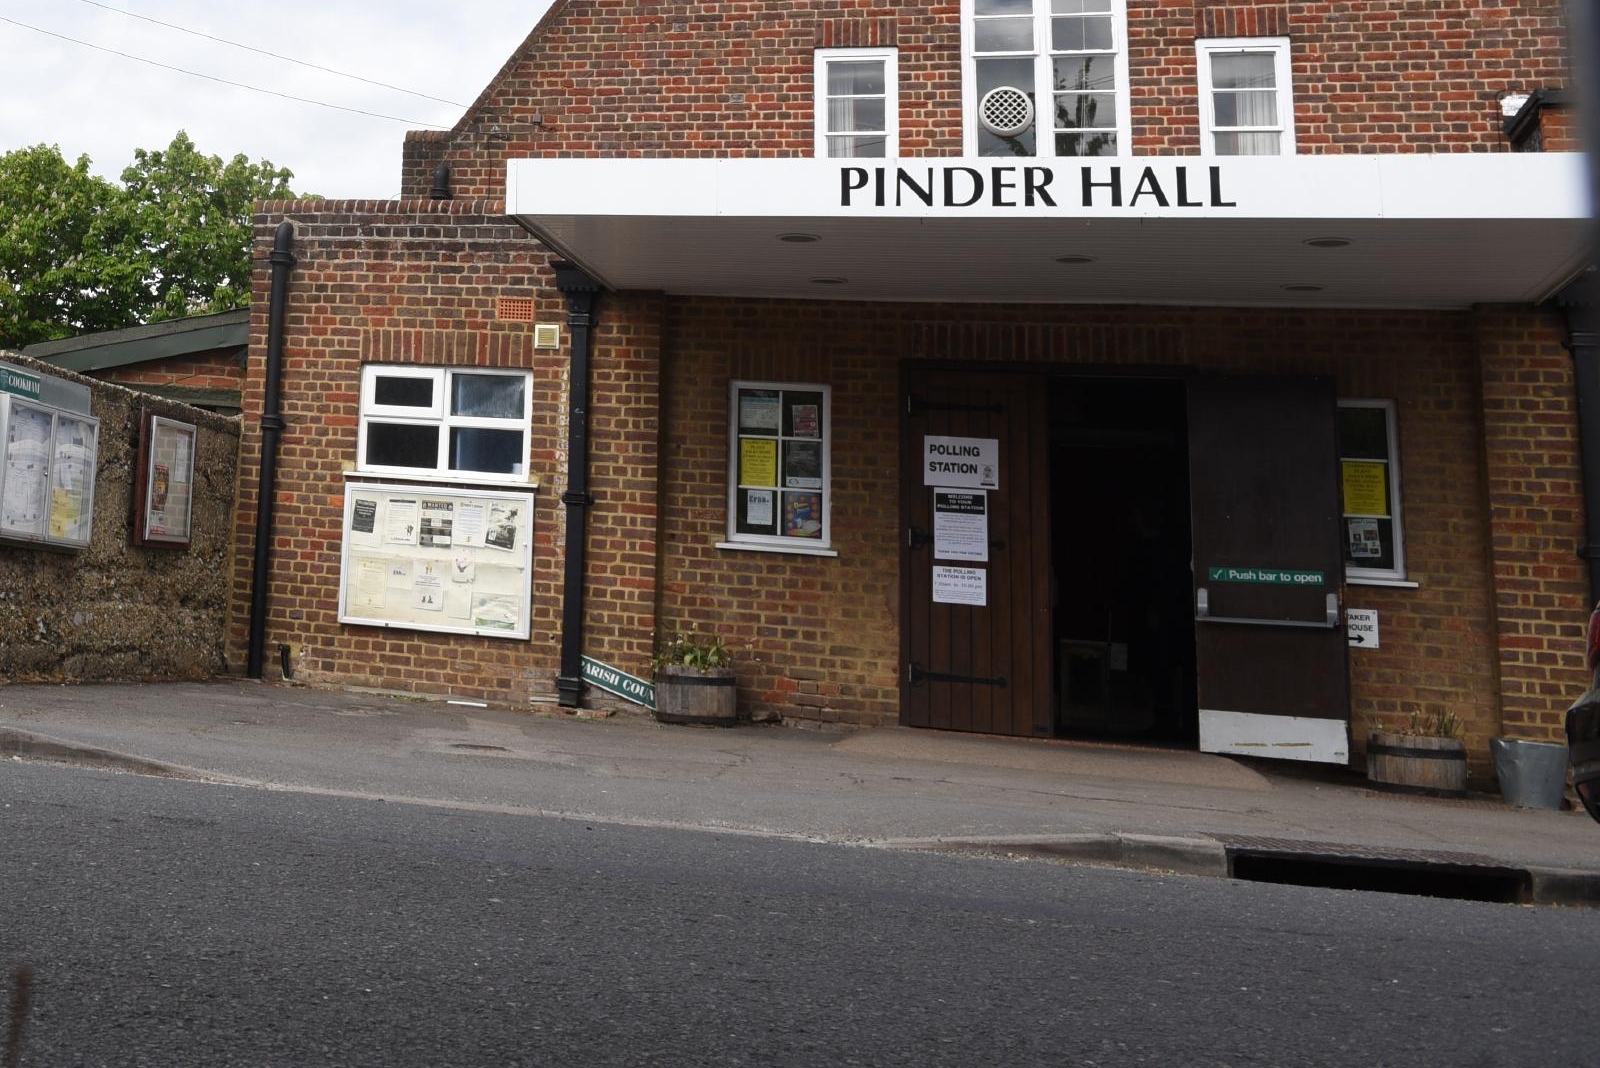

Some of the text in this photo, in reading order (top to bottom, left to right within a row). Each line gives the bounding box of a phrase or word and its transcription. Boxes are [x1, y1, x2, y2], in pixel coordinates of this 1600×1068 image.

[840, 166, 1238, 207] PINDER HALL
[8, 374, 40, 394] COOKHAM
[929, 444, 980, 457] POLLING
[929, 461, 978, 474] STATION
[1228, 569, 1322, 585] Push bar to open
[581, 660, 620, 686] ARISH
